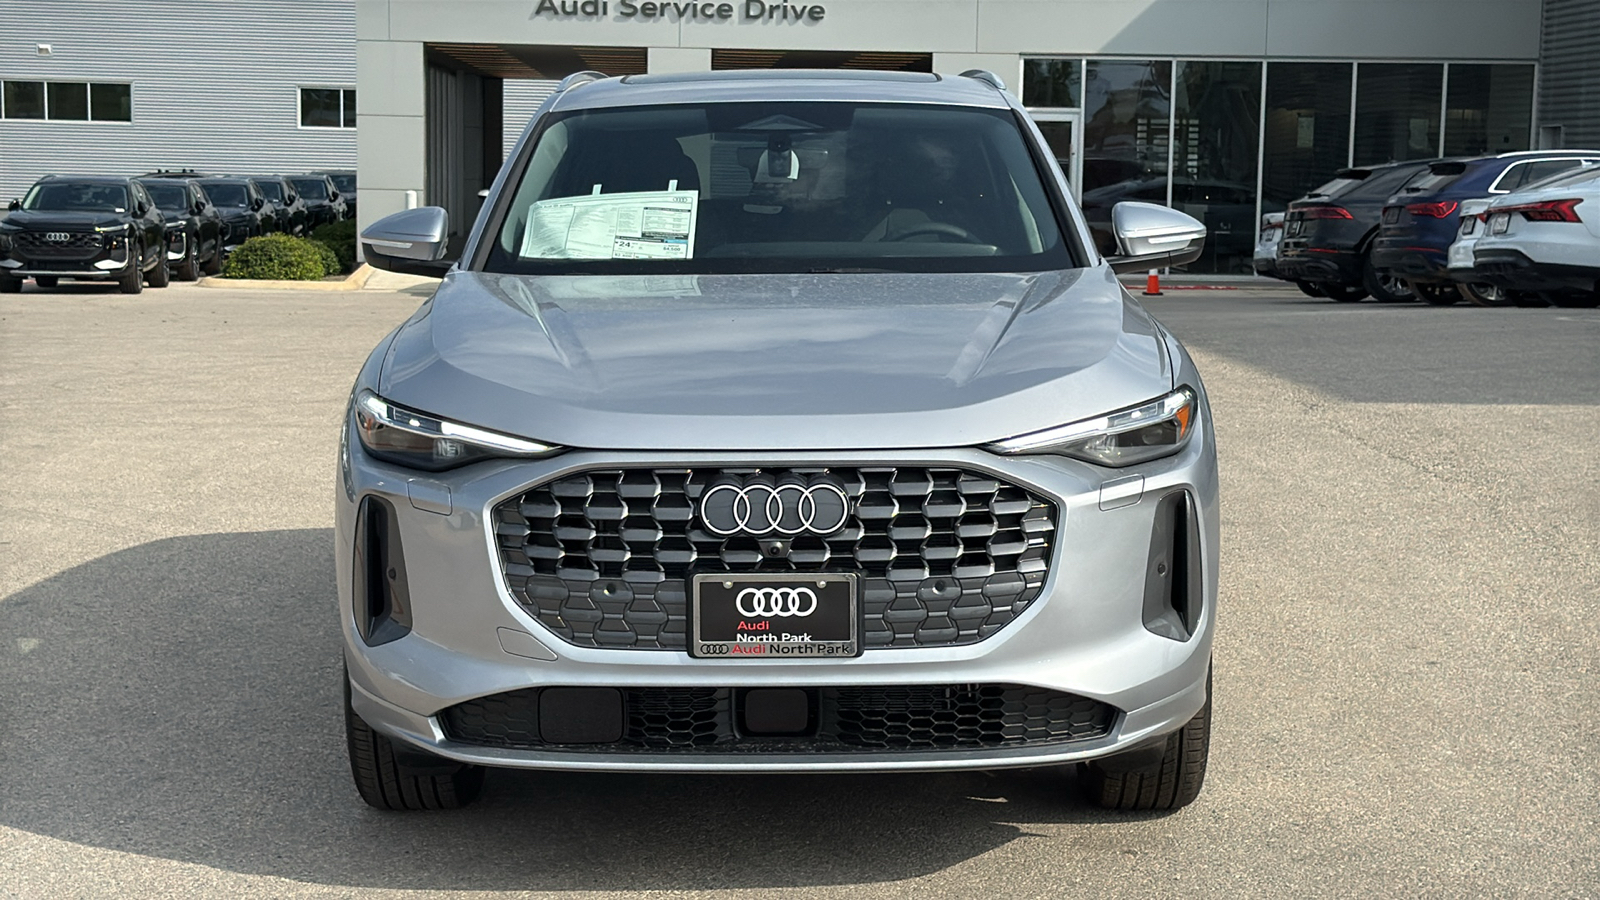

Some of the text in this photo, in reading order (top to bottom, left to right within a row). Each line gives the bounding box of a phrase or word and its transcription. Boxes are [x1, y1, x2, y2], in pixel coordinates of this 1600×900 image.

[535, 0, 826, 21] Audi Service Drive
[737, 621, 770, 630] Audi
[736, 633, 812, 642] North Park
[731, 644, 850, 654] Audi North Park
